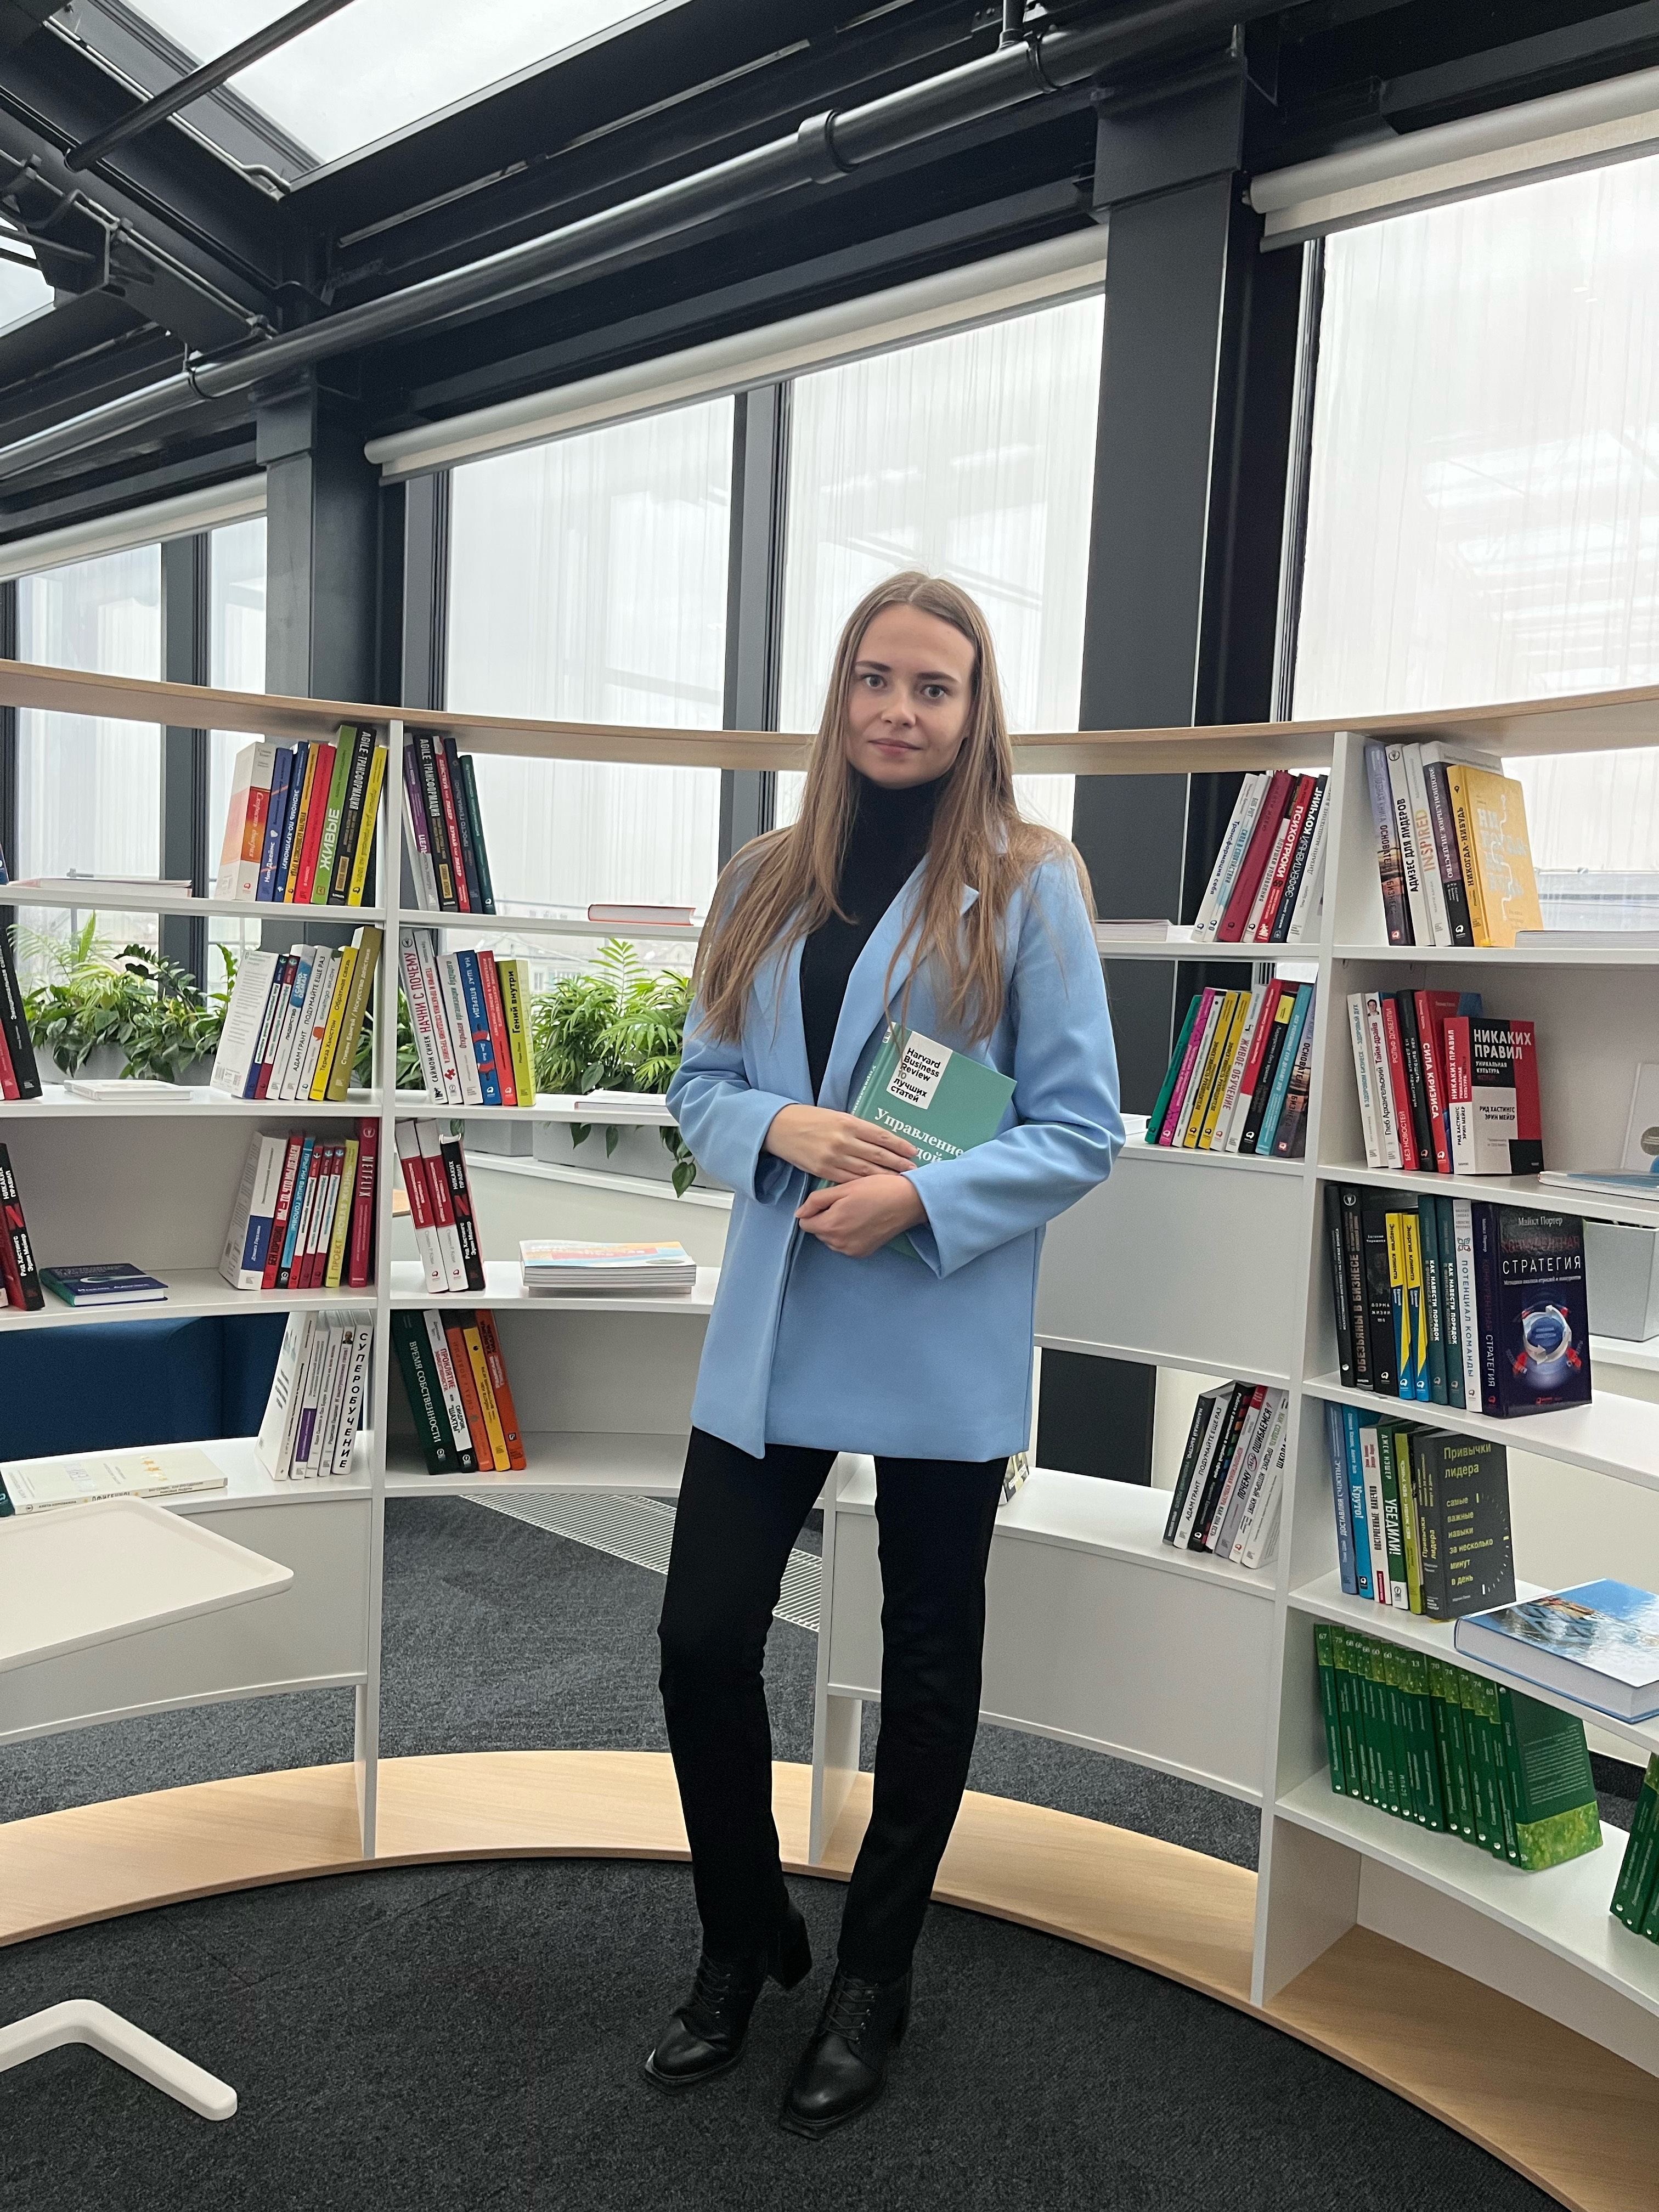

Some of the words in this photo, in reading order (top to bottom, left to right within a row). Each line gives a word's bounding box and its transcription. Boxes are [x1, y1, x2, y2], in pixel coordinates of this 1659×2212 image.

[251, 791, 263, 827] Скорость
[289, 789, 299, 820] ЭКОНОМЬ
[1246, 807, 1255, 818] РОТ
[1250, 797, 1258, 808] БОБ
[1397, 798, 1412, 838] ЛИДЕРОВ
[1428, 766, 1445, 832] ЭМОЦИОНАЛЬНОЕ
[1440, 833, 1453, 878] ЛИДЕРСТВО
[248, 830, 257, 857] доверия
[281, 821, 294, 869] ПО-КРУПНОМУ!
[319, 808, 340, 870] ЖИВЫЕ
[1215, 820, 1240, 878] Трансформация
[1237, 828, 1248, 843] СИЛА
[1276, 805, 1304, 879] ПСИХОТРЮКИ
[1284, 835, 1310, 898] ЭФФЕКТИВНЫЙ
[1303, 786, 1324, 834] КОУЧИНГ
[1403, 840, 1414, 858] ДЛЯ
[1414, 808, 1435, 872] INSPIRED
[1457, 806, 1475, 885] НИКОГДА-НИБУДЬ
[1269, 837, 1284, 865] Ловушки
[1224, 848, 1242, 884] СПОКОЙСТВИИ
[1406, 859, 1419, 892] АДИЗЕС
[1209, 878, 1221, 895] себя
[1257, 866, 1274, 903] управления
[313, 968, 323, 983] ЕЩЕ
[317, 956, 326, 968] РАЗ
[404, 951, 422, 990] ПОЧЕМУ
[464, 957, 472, 968] НА
[466, 969, 475, 984] ШАГ
[506, 971, 518, 1004] внутри
[303, 983, 319, 1025] ПОДУМАЙТЕ
[319, 1048, 331, 1071] Тереза
[325, 1020, 337, 1048] Хьюстон
[333, 979, 347, 1011] Обратная
[341, 958, 351, 978] связь
[469, 987, 480, 1018] ВПЕРЕДИ
[285, 1008, 297, 1040] ЛИДЕРСТВО
[414, 1002, 431, 1034] НАЧНИ
[510, 1006, 521, 1033] Гений
[1355, 1015, 1363, 1044] ЗДОРОВЫЙ
[1386, 1007, 1396, 1039] ДОБЕЛЛИ
[297, 1030, 308, 1051] ГРАНТ
[422, 1035, 433, 1056] СИНЕК
[1269, 1025, 1282, 1054] Лидерство
[1370, 1022, 1383, 1063] Тайм-драйв
[1390, 1040, 1398, 1063] РОЛЬФ
[1474, 1029, 1531, 1046] НИКАКИХ
[1475, 1044, 1522, 1059] ПРАВИЛ
[292, 1051, 303, 1071] АДАМ
[907, 1047, 941, 1069] Harvard
[1234, 1038, 1250, 1066] ЖИВОЕ
[1358, 1051, 1367, 1073] БИЗНЕСЕ
[1422, 1042, 1433, 1070] СИЛА
[427, 1057, 439, 1082] САЙМОН
[898, 1070, 907, 1080] 10
[902, 1063, 930, 1081] Review
[904, 1056, 939, 1077] Business
[1262, 1064, 1272, 1083] вранья
[891, 1086, 919, 1102] статей
[894, 1078, 927, 1097] лучших
[1222, 1069, 1242, 1110] ОБУЧЕНИЕ
[1361, 1074, 1369, 1102] ЗДОРОВОМ
[1376, 1066, 1390, 1118] Архангельский
[1425, 1073, 1438, 1119] КРИЗИСА
[874, 1108, 964, 1157] Управление
[1383, 1119, 1392, 1135] Глеб
[1399, 1110, 1409, 1147] НОВОСТЕЙ
[299, 1153, 309, 1180] ПРЫГНИ
[359, 1156, 374, 1197] NETFLIX
[448, 1160, 458, 1189] НИКАКИХ
[456, 1164, 465, 1188] ПРАВИЛ
[5, 1170, 15, 1197] ПРАВИЛ
[296, 1181, 304, 1200] ВЫШЕ
[1518, 1217, 1539, 1226] Майкл
[1541, 1216, 1563, 1227] Портер
[13, 1235, 24, 1263] Хастингс
[1349, 1254, 1362, 1301] БИЗНЕСЕ
[1503, 1256, 1581, 1274] СТРАТЕГИЯ
[1460, 1260, 1470, 1321] ПОТЕНЦИАЛ
[1353, 1314, 1366, 1372] ОБЕЗЬЯНЫ
[1464, 1325, 1474, 1376] КОМАНДЫ
[440, 1347, 455, 1389] ПРОКЛЯТИЕ
[339, 1333, 368, 1468] СУПЕРОБУЧЕНИЕ
[409, 1340, 422, 1369] ВРЕМЯ
[416, 1370, 441, 1442] СОБСТВЕННОСТИ
[1209, 1420, 1218, 1434] ЕЩЕ
[1213, 1407, 1222, 1419] РАЗ
[1198, 1435, 1214, 1475] ПОДУМАЙТЕ
[1444, 1443, 1491, 1460] Привычки
[1333, 1460, 1344, 1497] счастье
[1383, 1455, 1391, 1479] НЭШЕР
[1445, 1464, 1479, 1479] лидера
[1190, 1480, 1201, 1500] ГРАНТ
[1350, 1485, 1365, 1519] Круто!
[1369, 1485, 1378, 1509] НАВЕЧНО
[1447, 1497, 1468, 1507] самые
[1185, 1501, 1196, 1521] АДАМ
[1337, 1498, 1347, 1537] ДОСТАВЛЯЯ
[1447, 1511, 1474, 1523] важные
[1371, 1512, 1381, 1550] ПОСТРОЕННЫЕ
[1383, 1498, 1402, 1555] УБЕДИЛИ!
[1418, 1517, 1430, 1558] Привычки
[1448, 1526, 1474, 1538] навыки
[1428, 1530, 1438, 1559] лидера
[1459, 1537, 1493, 1552] несколько
[1450, 1559, 1470, 1569] минут
[1457, 1575, 1474, 1585] день
